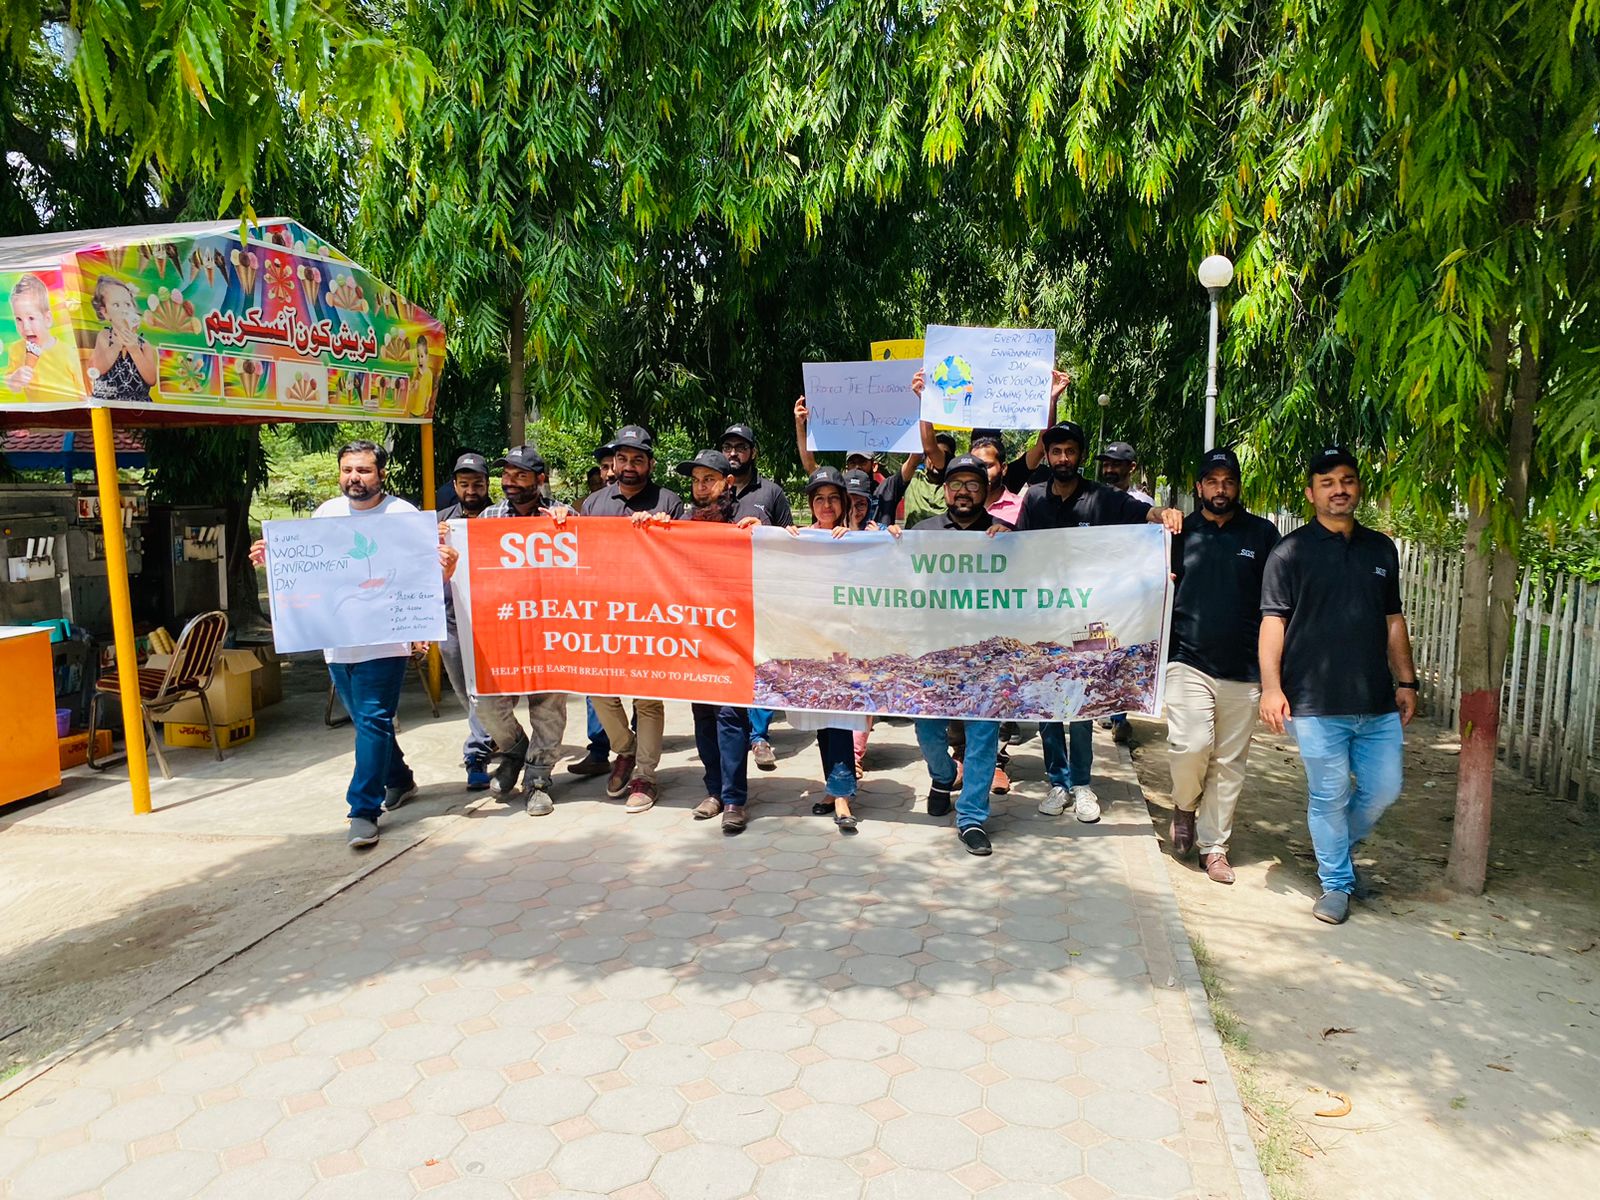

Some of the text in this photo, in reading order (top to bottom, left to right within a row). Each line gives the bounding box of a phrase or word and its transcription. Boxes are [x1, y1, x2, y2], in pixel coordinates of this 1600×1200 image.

[295, 320, 333, 355] کون
[993, 333, 1025, 344] EVERY
[1008, 361, 1030, 371] DAY
[987, 375, 1009, 386] SAVE
[1009, 375, 1034, 387] YOUR
[843, 411, 855, 427] A
[271, 544, 324, 558] WORLD
[500, 531, 578, 568] SGS
[1240, 549, 1255, 559] SGS
[273, 557, 352, 576] ENVIRONMENT
[911, 553, 1007, 574] WORLD
[275, 578, 297, 591] DAY
[833, 585, 1094, 609] ENVIRONMENT DAY
[497, 599, 737, 629] #BEAT PLASTIC
[543, 631, 702, 658] POLUTION
[491, 664, 733, 685] HELP THE EARTH BREATHE, SAY NO TO PLASTICS.
